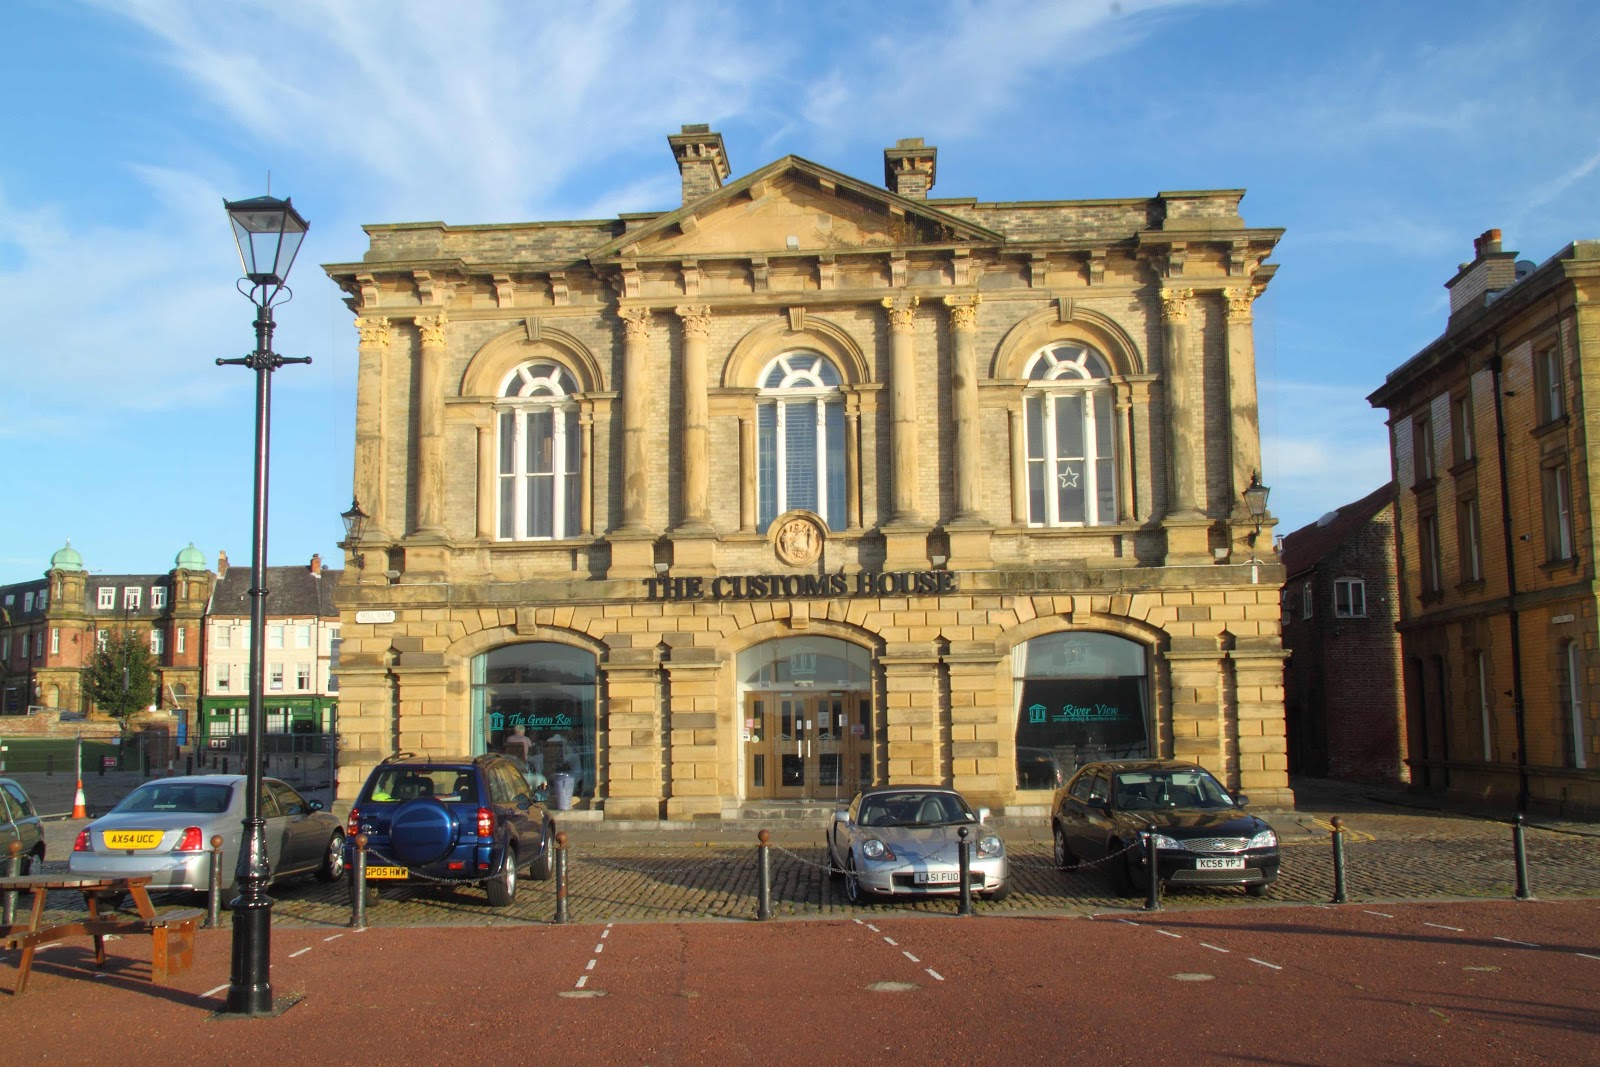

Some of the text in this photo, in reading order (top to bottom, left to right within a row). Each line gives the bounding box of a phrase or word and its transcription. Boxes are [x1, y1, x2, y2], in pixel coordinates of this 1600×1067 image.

[642, 571, 956, 600] THE CUSTOMS HOUSE
[1063, 703, 1119, 717] River View
[508, 712, 526, 724] The
[527, 713, 553, 726] Green
[111, 834, 155, 844] AX54 UCC
[1200, 859, 1242, 868] KC56 VPJ
[365, 867, 388, 876] GP05
